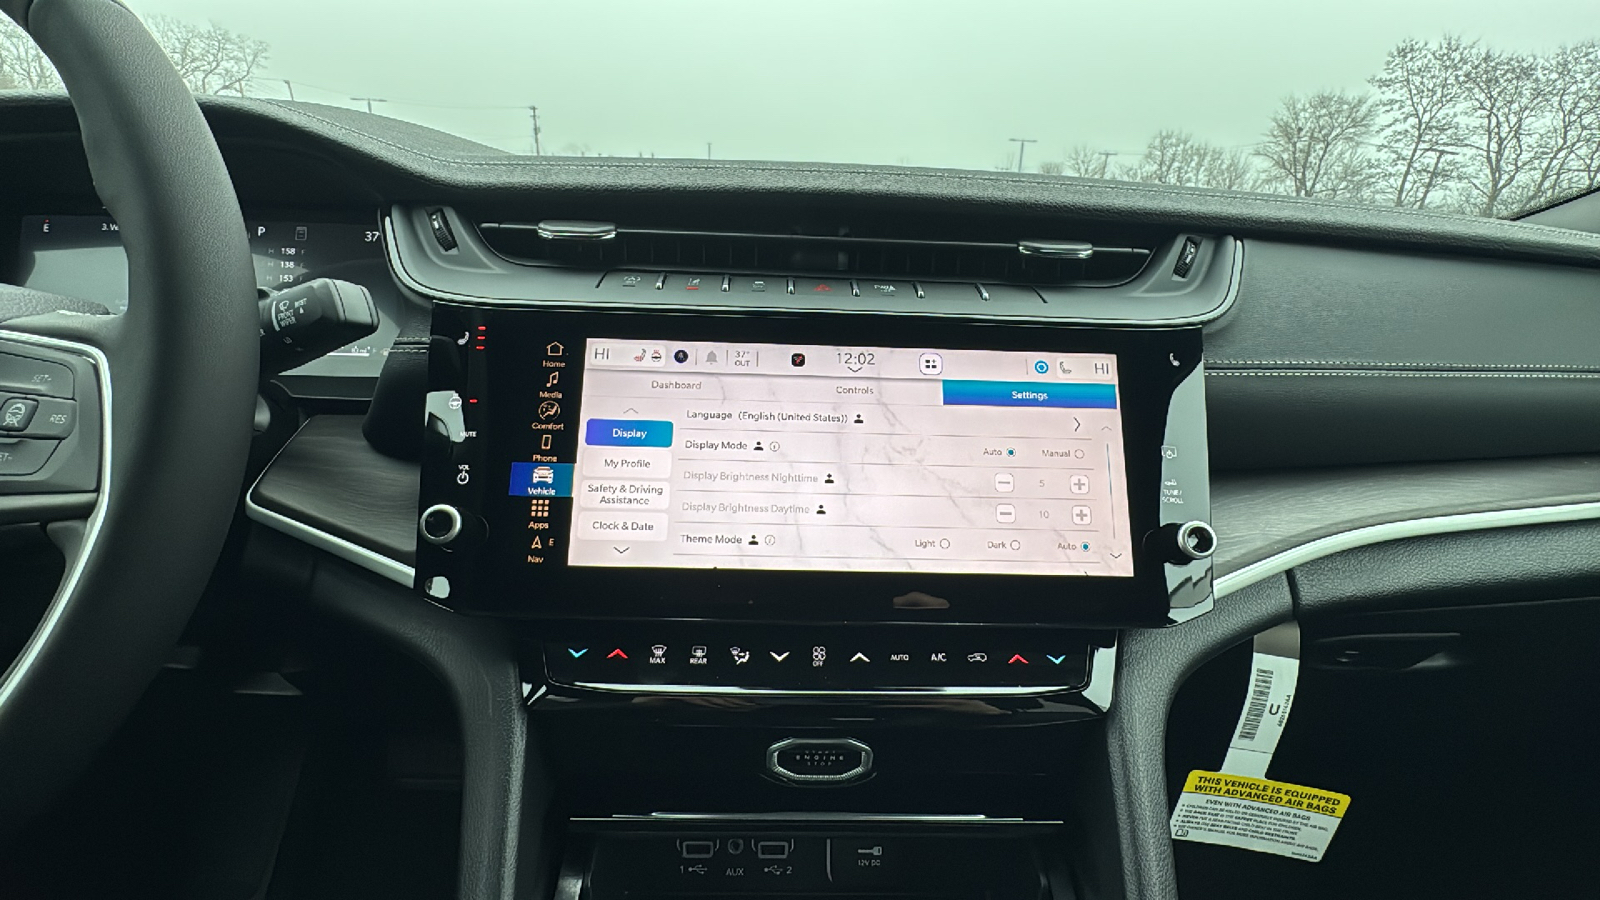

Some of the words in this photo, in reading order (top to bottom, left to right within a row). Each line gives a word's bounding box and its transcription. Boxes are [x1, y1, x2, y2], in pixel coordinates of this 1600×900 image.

[43, 223, 50, 232] E
[257, 226, 266, 236] P
[281, 247, 296, 256] 158
[280, 261, 295, 269] 138
[279, 274, 294, 283] 153
[594, 347, 610, 360] HI
[542, 359, 566, 368] Home
[734, 359, 751, 367] OUT
[836, 352, 876, 366] 12:02
[1094, 362, 1110, 376] HI
[651, 380, 702, 390] Dashboard
[539, 391, 563, 399] Media
[835, 386, 874, 396] Controls
[1011, 389, 1049, 401] Settings
[49, 414, 68, 424] RES
[686, 410, 733, 420] Language
[738, 411, 776, 422] (English
[777, 412, 811, 422] (United
[812, 413, 849, 423] States))
[531, 422, 565, 431] Comfort
[612, 428, 648, 440] Display
[684, 440, 720, 451] Display
[721, 441, 748, 450] Mode
[982, 447, 1003, 456] Auto
[1041, 449, 1071, 459] Manual
[532, 454, 558, 463] Phone
[604, 459, 619, 469] My
[620, 459, 651, 468] Profile
[682, 470, 718, 482] Display
[719, 471, 770, 483] Brightness
[771, 473, 819, 484] Nighttime
[1038, 479, 1046, 488] 5
[527, 487, 556, 496] Vehicle
[587, 484, 618, 495] Safety
[619, 484, 627, 493] &
[629, 484, 664, 496] Driving
[599, 495, 650, 505] Assistance
[1161, 496, 1184, 504] SCROLL
[681, 502, 717, 513] Display
[718, 503, 769, 514] Brightness
[770, 504, 810, 515] Daytime
[1038, 510, 1050, 519] 10
[527, 521, 550, 531] Apps
[592, 521, 620, 530] Clock
[621, 521, 629, 531] &
[631, 522, 654, 531] Date
[548, 538, 555, 547] E
[681, 534, 713, 544] Theme
[714, 535, 743, 545] Mode
[914, 539, 936, 549] Light
[986, 541, 1007, 550] Dark
[1056, 542, 1078, 551] Auto
[527, 554, 544, 564] Nav
[649, 656, 666, 664] MAX
[689, 657, 708, 665] REAR
[889, 653, 909, 662] AUTO
[930, 652, 948, 662] A/C
[812, 660, 824, 668] OFF
[1197, 776, 1223, 786] THIS
[1224, 778, 1270, 793] VEHICLE
[1271, 786, 1283, 795] IS
[1284, 789, 1341, 807] EQUIPPED
[1194, 784, 1222, 794] WITH
[1223, 788, 1284, 804] ADVANCED
[1284, 797, 1304, 808] AIR
[1306, 801, 1338, 815] BAGS
[1224, 801, 1242, 809] WITH
[1241, 803, 1279, 815] ADVANCED
[1279, 810, 1293, 818] AIR
[1293, 812, 1312, 821] BAGS
[725, 867, 744, 876] AUX
[786, 866, 793, 874] 2
